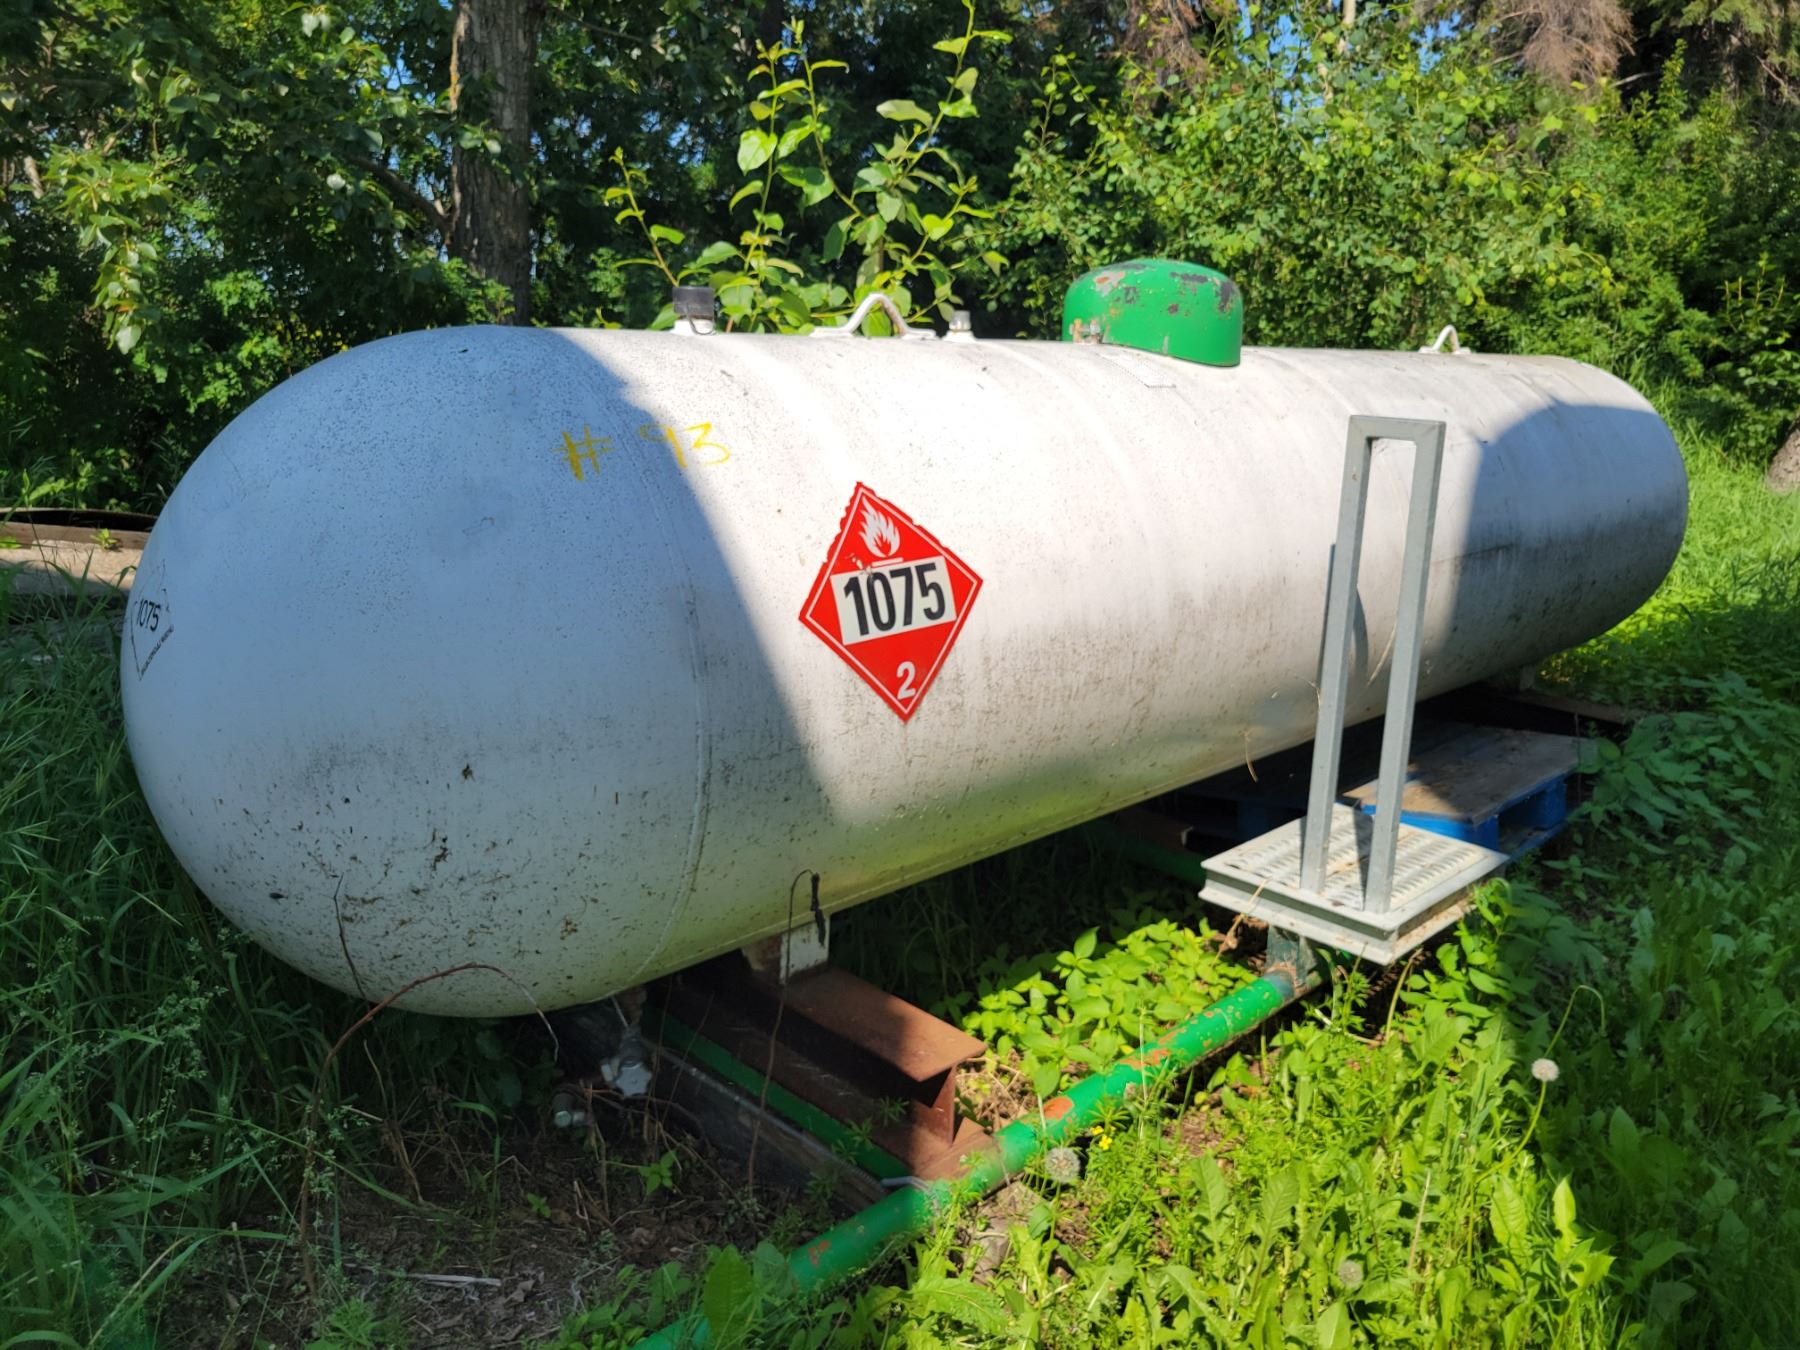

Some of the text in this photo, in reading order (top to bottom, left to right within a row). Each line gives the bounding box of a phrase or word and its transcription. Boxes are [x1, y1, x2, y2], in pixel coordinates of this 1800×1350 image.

[552, 424, 613, 482] #
[136, 598, 161, 632] 1075
[843, 562, 946, 637] 1075
[896, 660, 917, 700] 2
